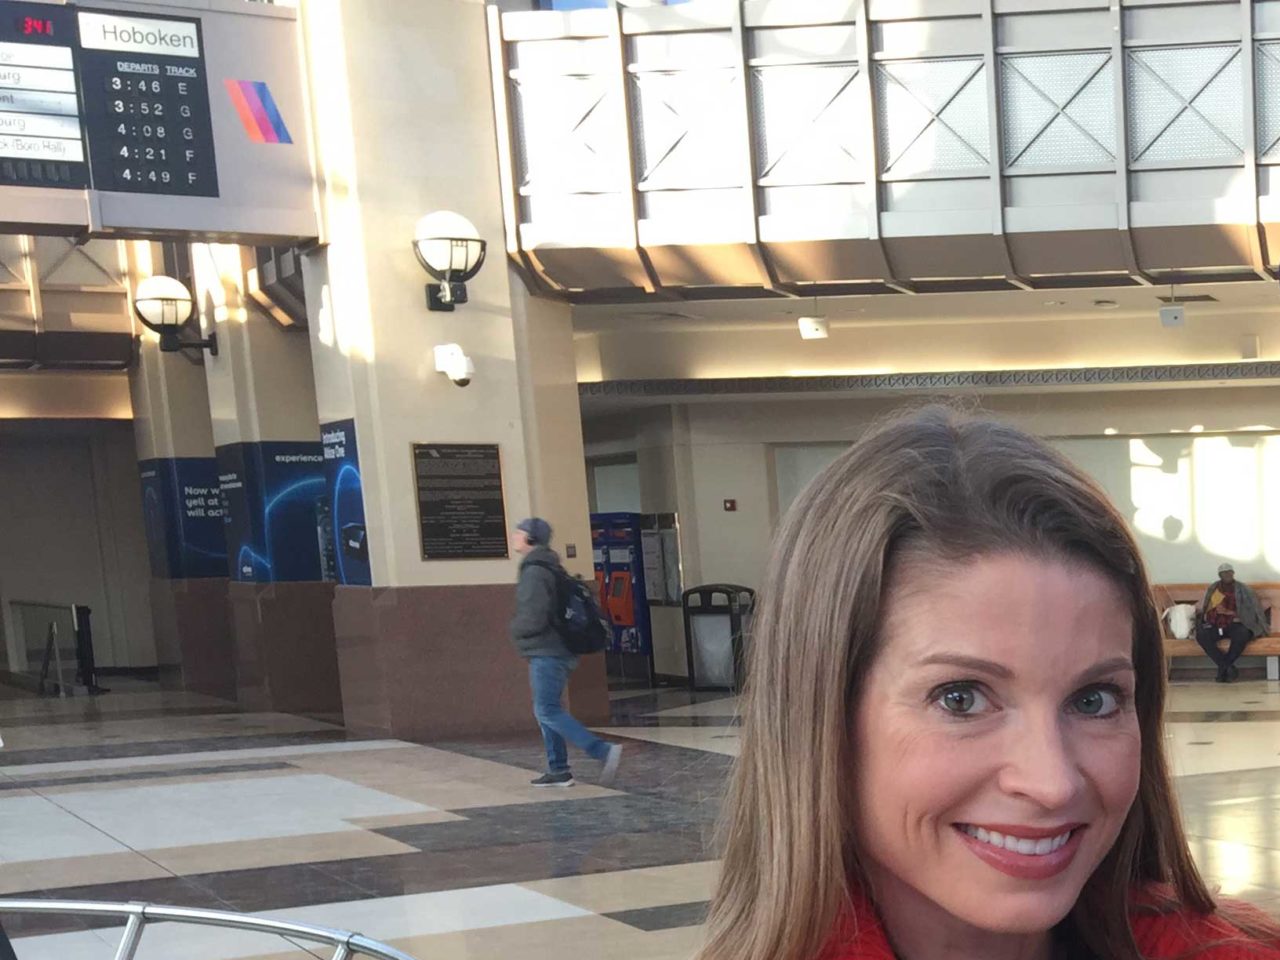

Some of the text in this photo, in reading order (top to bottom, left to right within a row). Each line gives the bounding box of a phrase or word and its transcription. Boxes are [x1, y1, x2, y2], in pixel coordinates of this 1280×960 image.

[102, 24, 194, 49] Hoboken
[116, 61, 198, 78] DEPARTS TRACK
[112, 77, 188, 95] 3:46 E
[114, 100, 191, 117] 3:52 G
[117, 123, 193, 139] 4:08 G
[120, 145, 195, 161] 4:21 F
[122, 168, 197, 184] 4:49 F
[275, 453, 323, 463] experience
[184, 486, 208, 496] Now
[186, 497, 205, 507] yell
[187, 507, 205, 517] will
